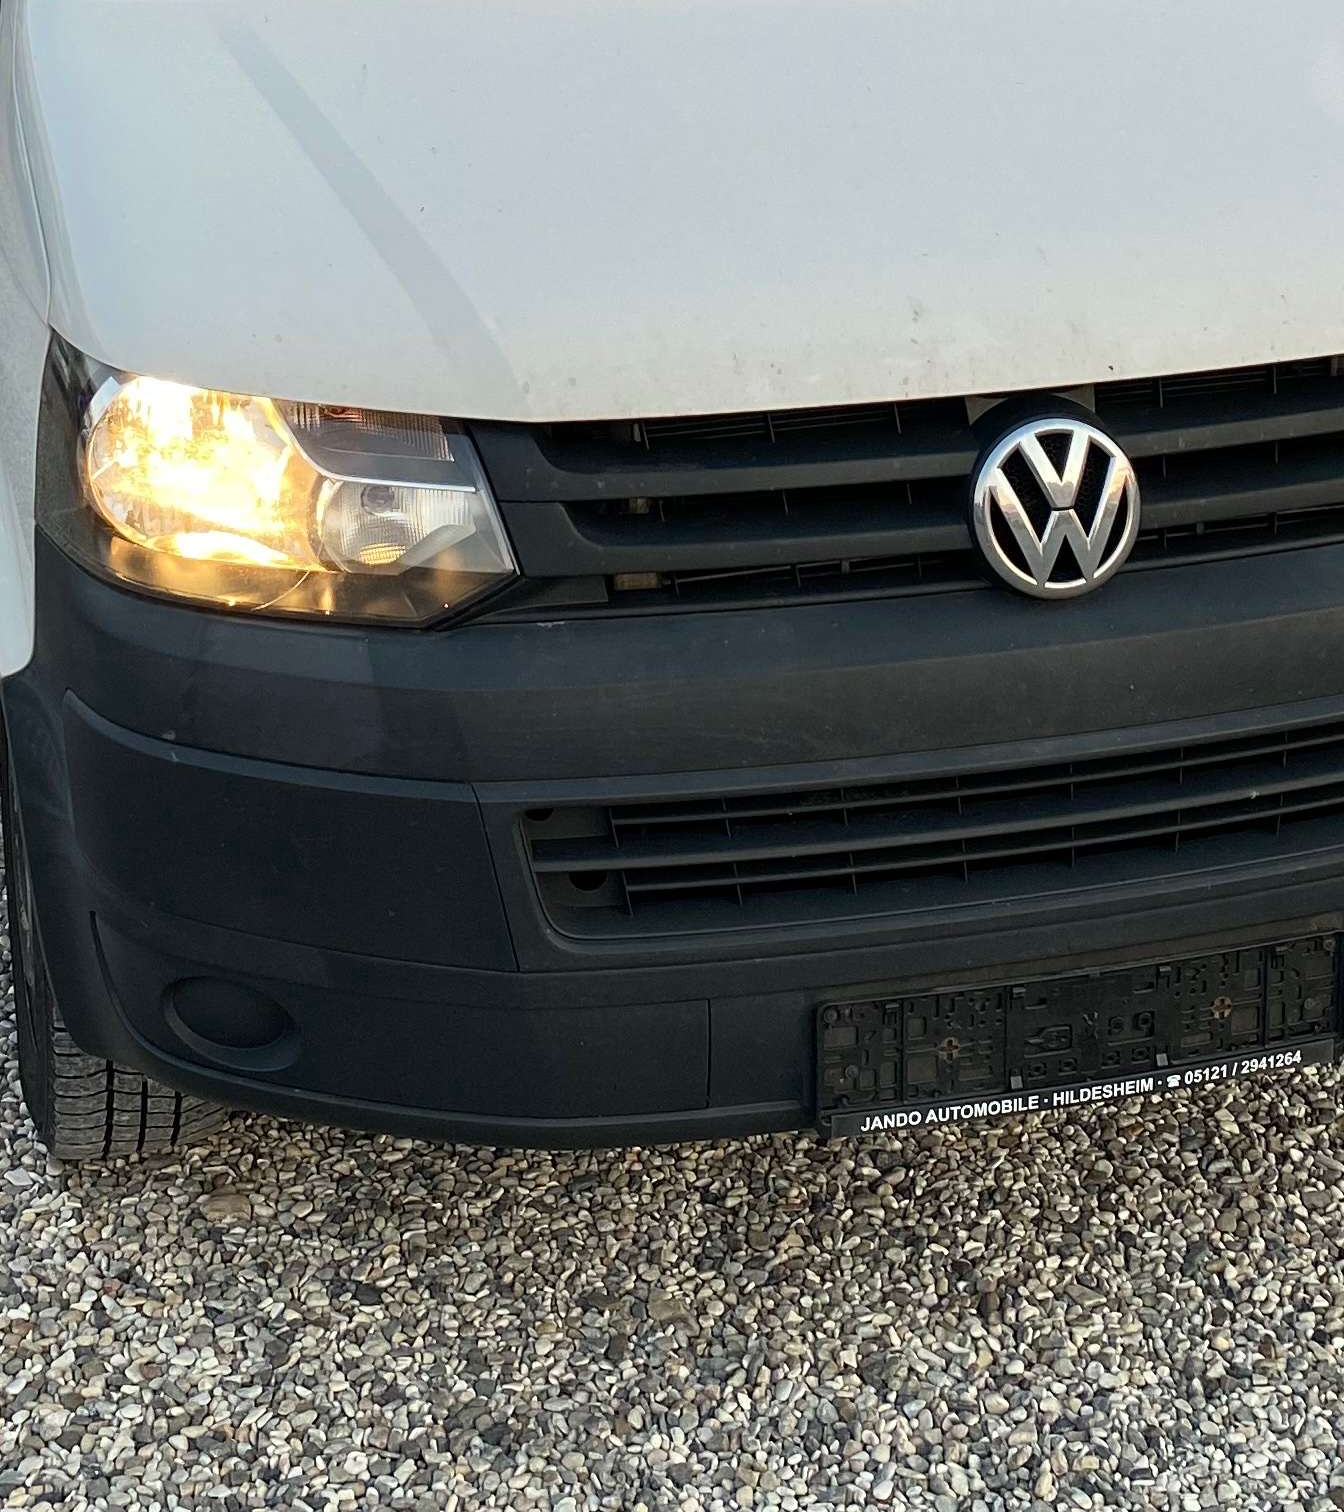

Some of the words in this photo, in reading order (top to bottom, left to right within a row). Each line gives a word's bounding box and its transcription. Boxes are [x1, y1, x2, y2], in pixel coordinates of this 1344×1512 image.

[860, 1110, 923, 1133] JANDO
[925, 1095, 1041, 1125] AUTOMOBILE
[1052, 1077, 1155, 1107] HILDESHEIM
[1183, 1064, 1229, 1086] 05121
[1241, 1049, 1303, 1075] 2941264
